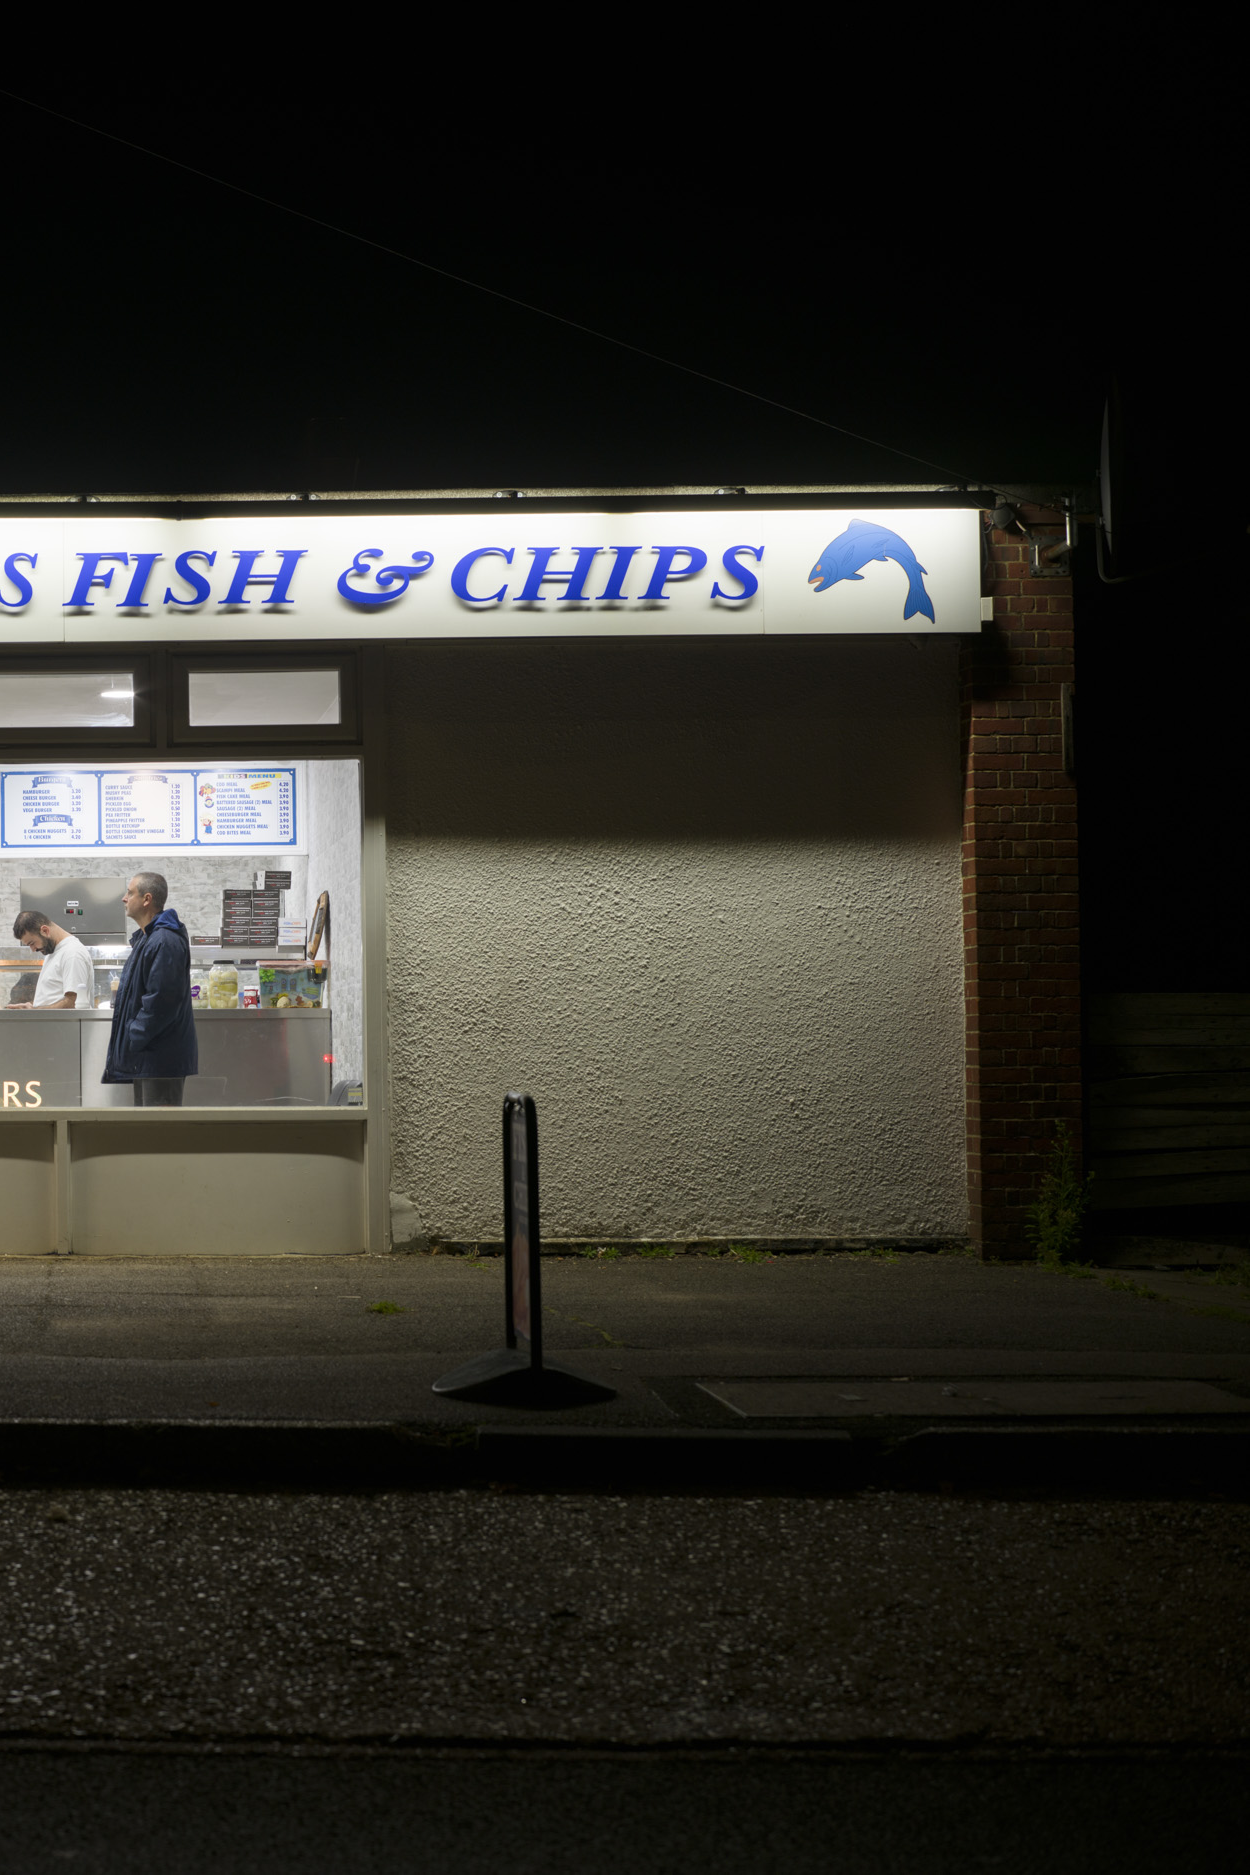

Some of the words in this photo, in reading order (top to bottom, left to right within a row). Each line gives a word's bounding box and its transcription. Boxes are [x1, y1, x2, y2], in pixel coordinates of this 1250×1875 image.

[62, 549, 309, 608] FISH
[337, 547, 435, 604] &
[450, 544, 766, 603] CHIPS
